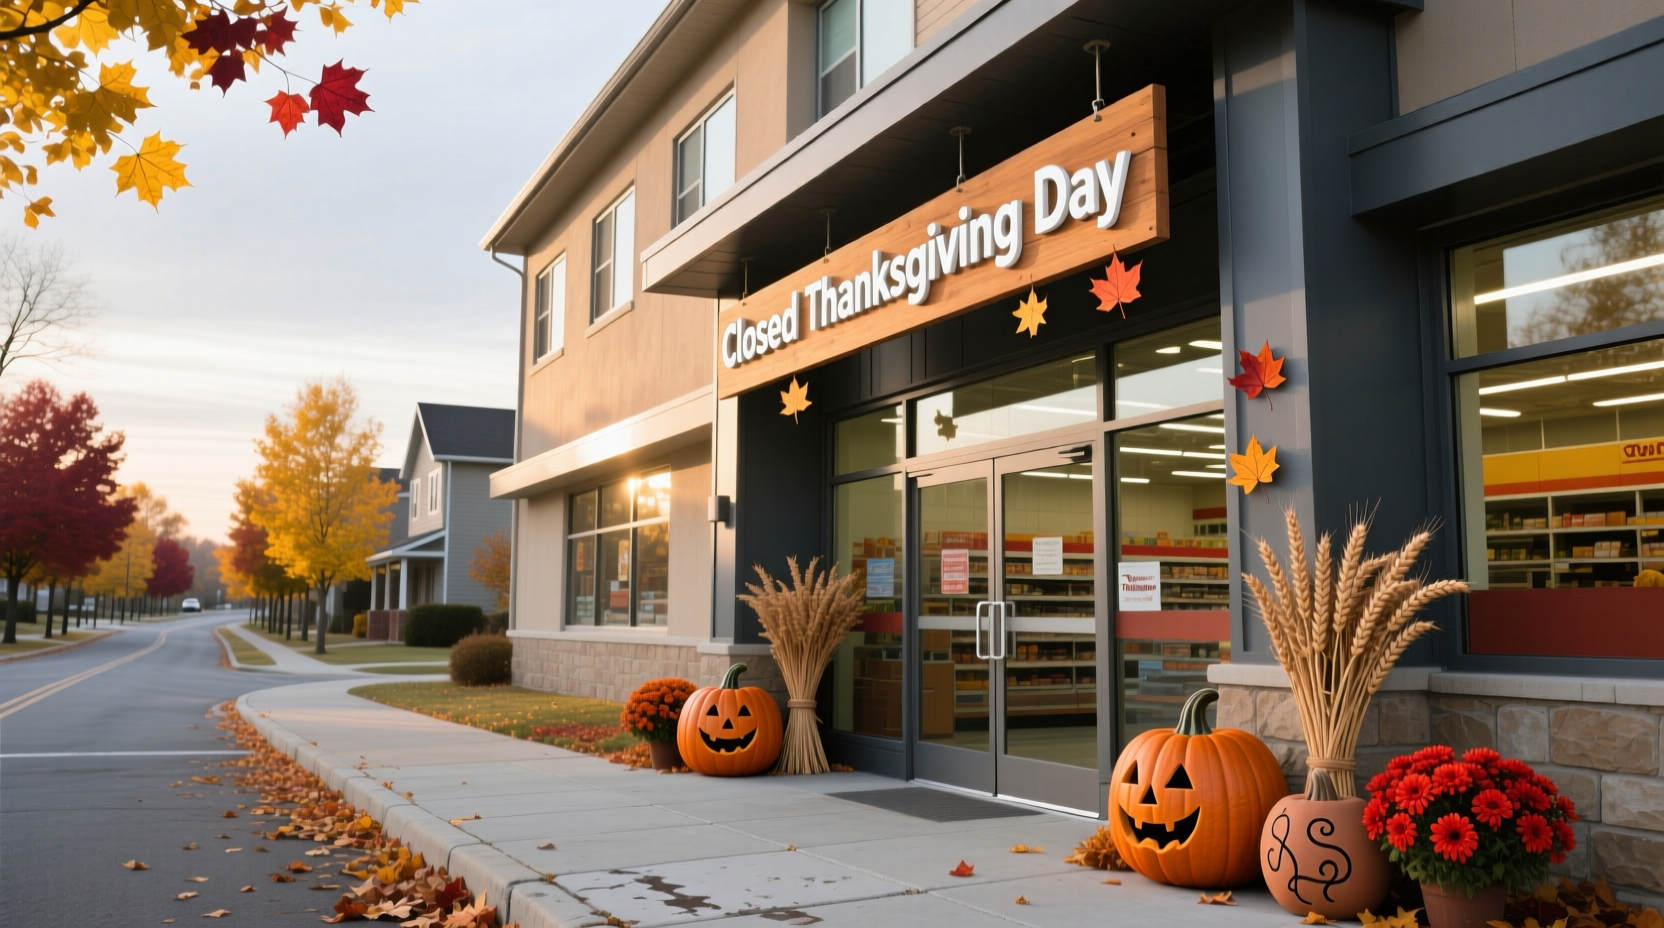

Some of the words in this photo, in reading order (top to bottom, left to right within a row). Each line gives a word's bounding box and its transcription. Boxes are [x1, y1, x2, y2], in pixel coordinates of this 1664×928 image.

[722, 290, 799, 368] Closed
[805, 199, 1023, 331] Thanksgiving
[1034, 150, 1132, 234] Day
